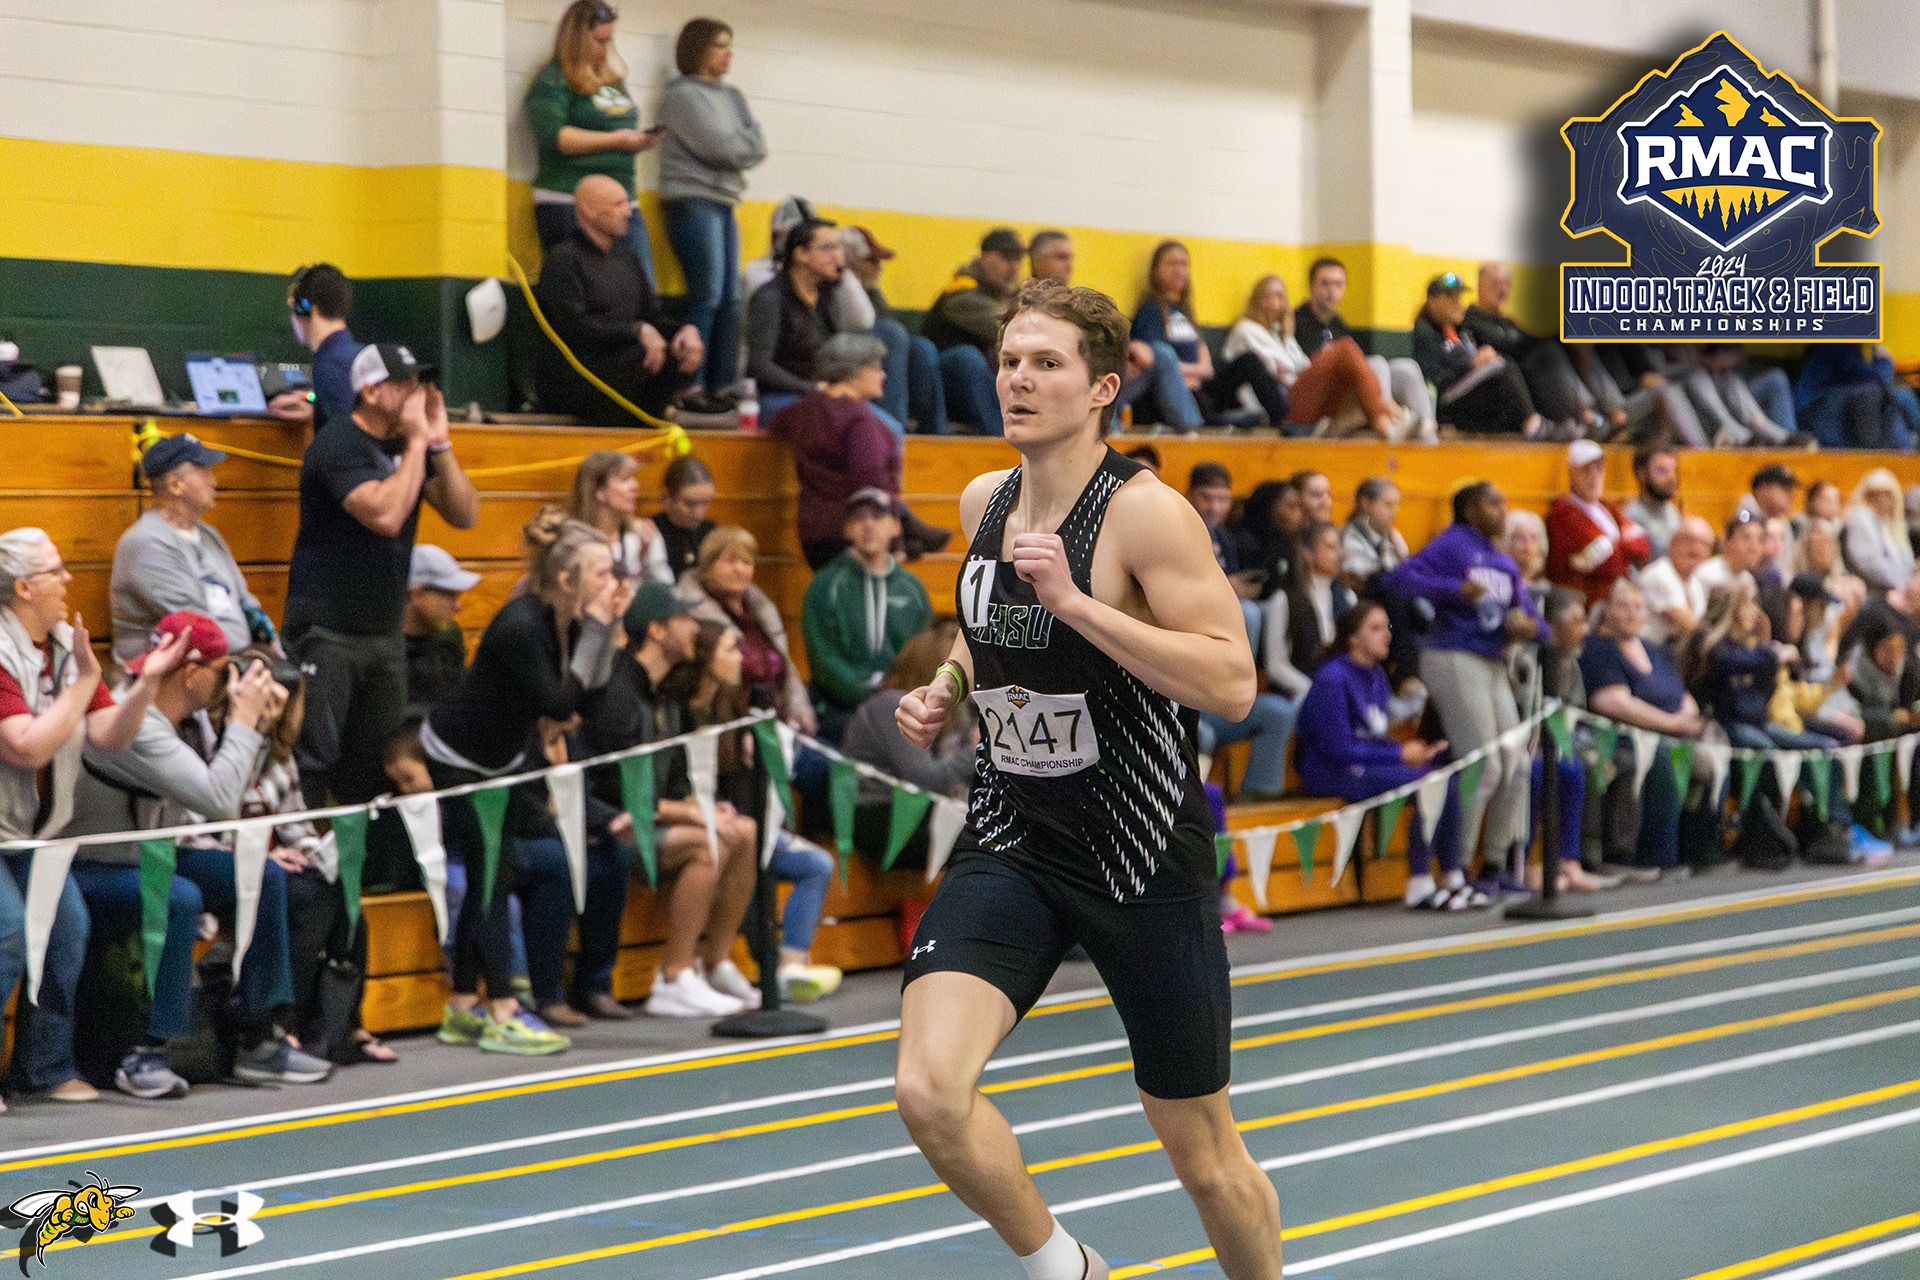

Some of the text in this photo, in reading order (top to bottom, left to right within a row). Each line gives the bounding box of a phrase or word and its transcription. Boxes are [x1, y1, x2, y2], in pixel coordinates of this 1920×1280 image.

[969, 564, 987, 624] 1
[971, 603, 1055, 649] HSU
[1006, 692, 1030, 701] RMAC
[984, 707, 1082, 754] 2147
[1001, 755, 1084, 769] RMAC CHAMPIONSHIP
